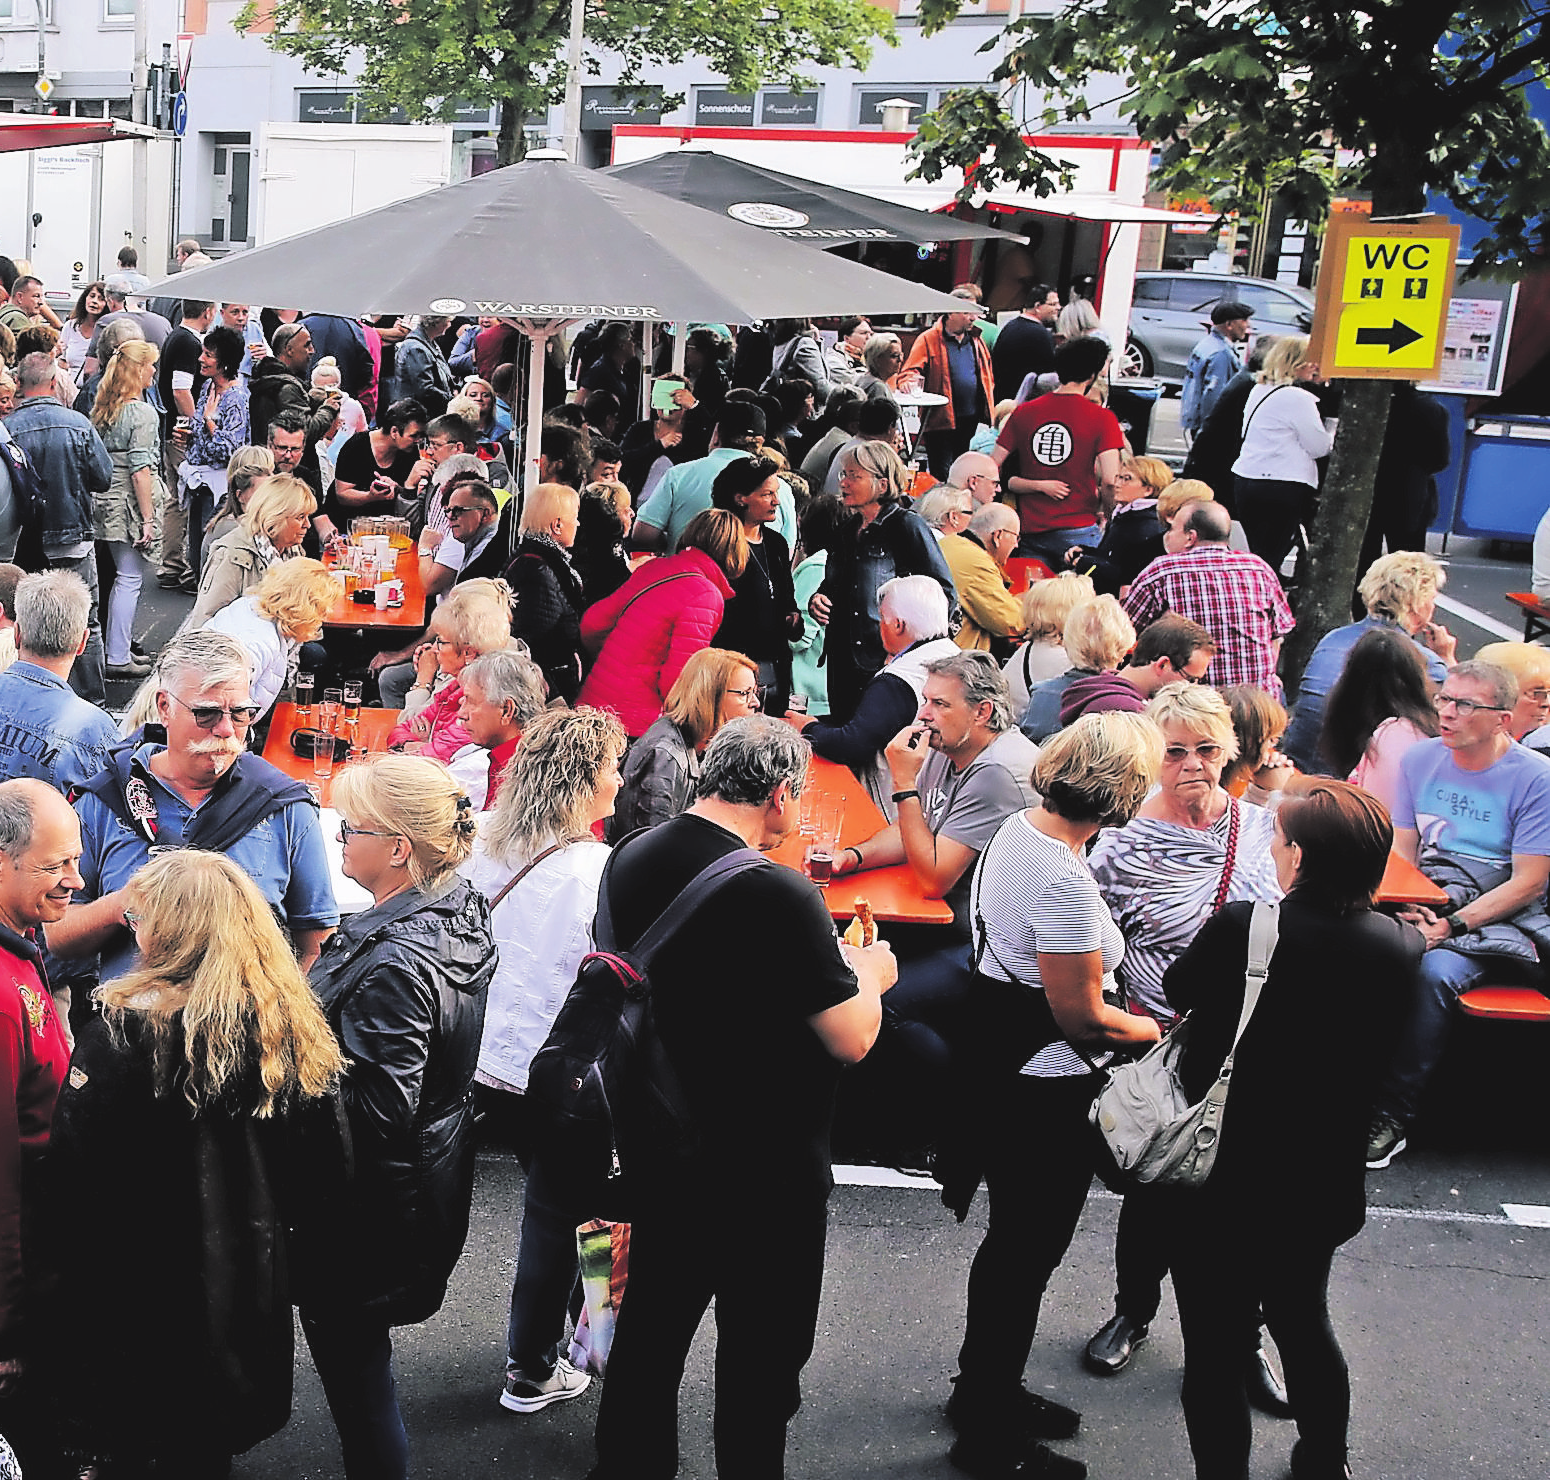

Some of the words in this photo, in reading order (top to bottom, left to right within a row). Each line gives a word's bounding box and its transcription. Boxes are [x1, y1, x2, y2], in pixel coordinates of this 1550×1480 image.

[697, 104, 752, 113] Sonnenschutz
[1363, 243, 1430, 270] WC
[472, 301, 662, 318] WARSTEINER
[1451, 804, 1491, 822] STYLE
